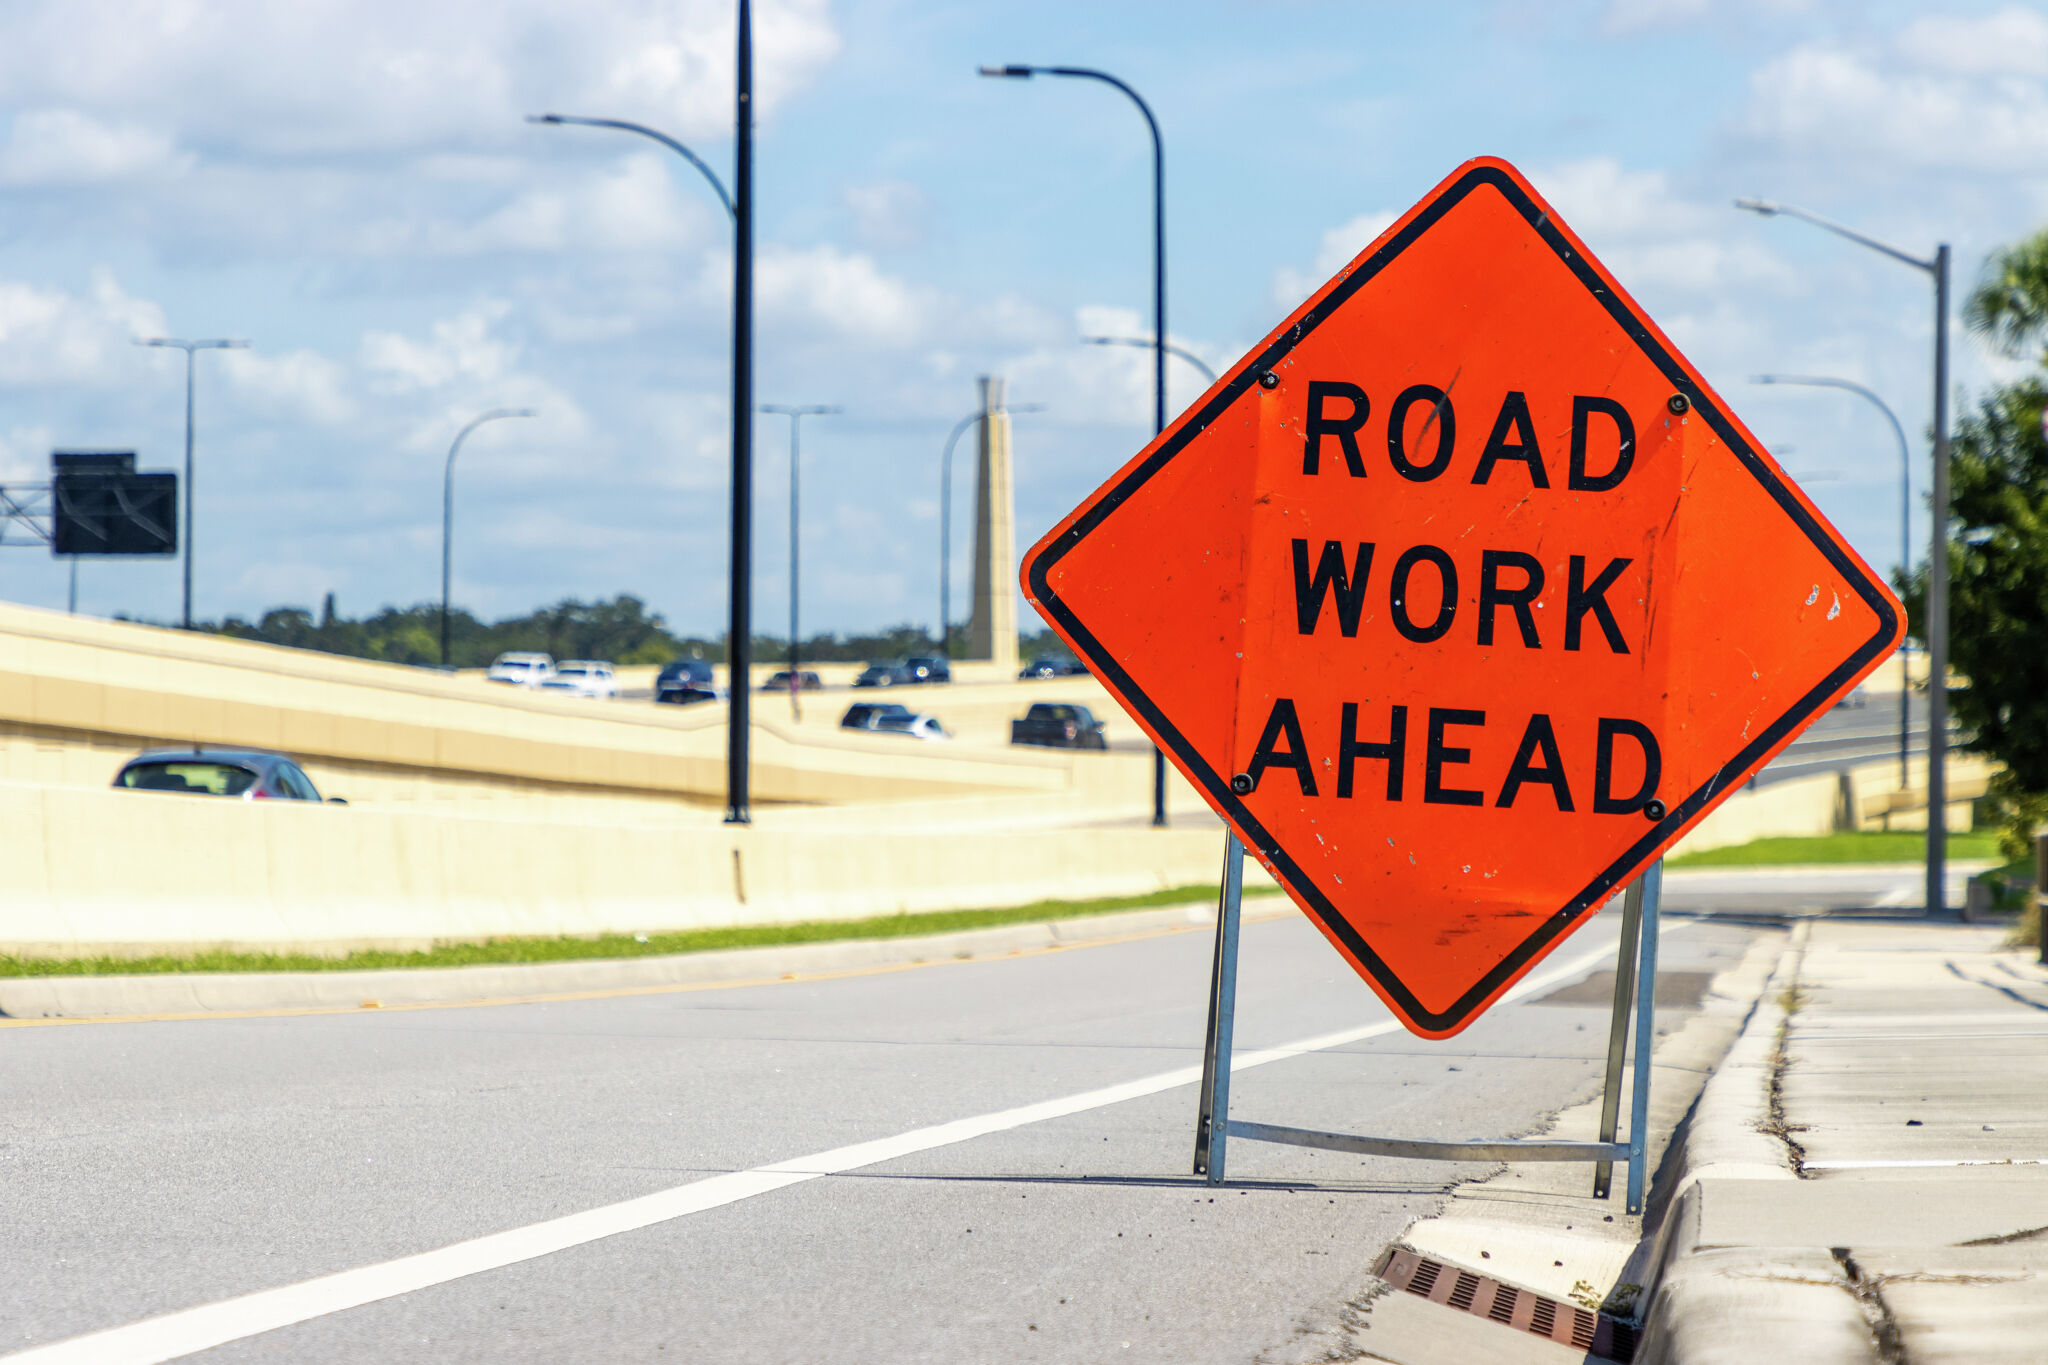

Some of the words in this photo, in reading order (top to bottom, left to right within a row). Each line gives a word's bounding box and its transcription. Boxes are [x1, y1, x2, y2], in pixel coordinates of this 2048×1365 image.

[1303, 381, 1636, 492] ROAD
[1292, 538, 1634, 654] WORK
[1243, 698, 1662, 816] AHEAD
